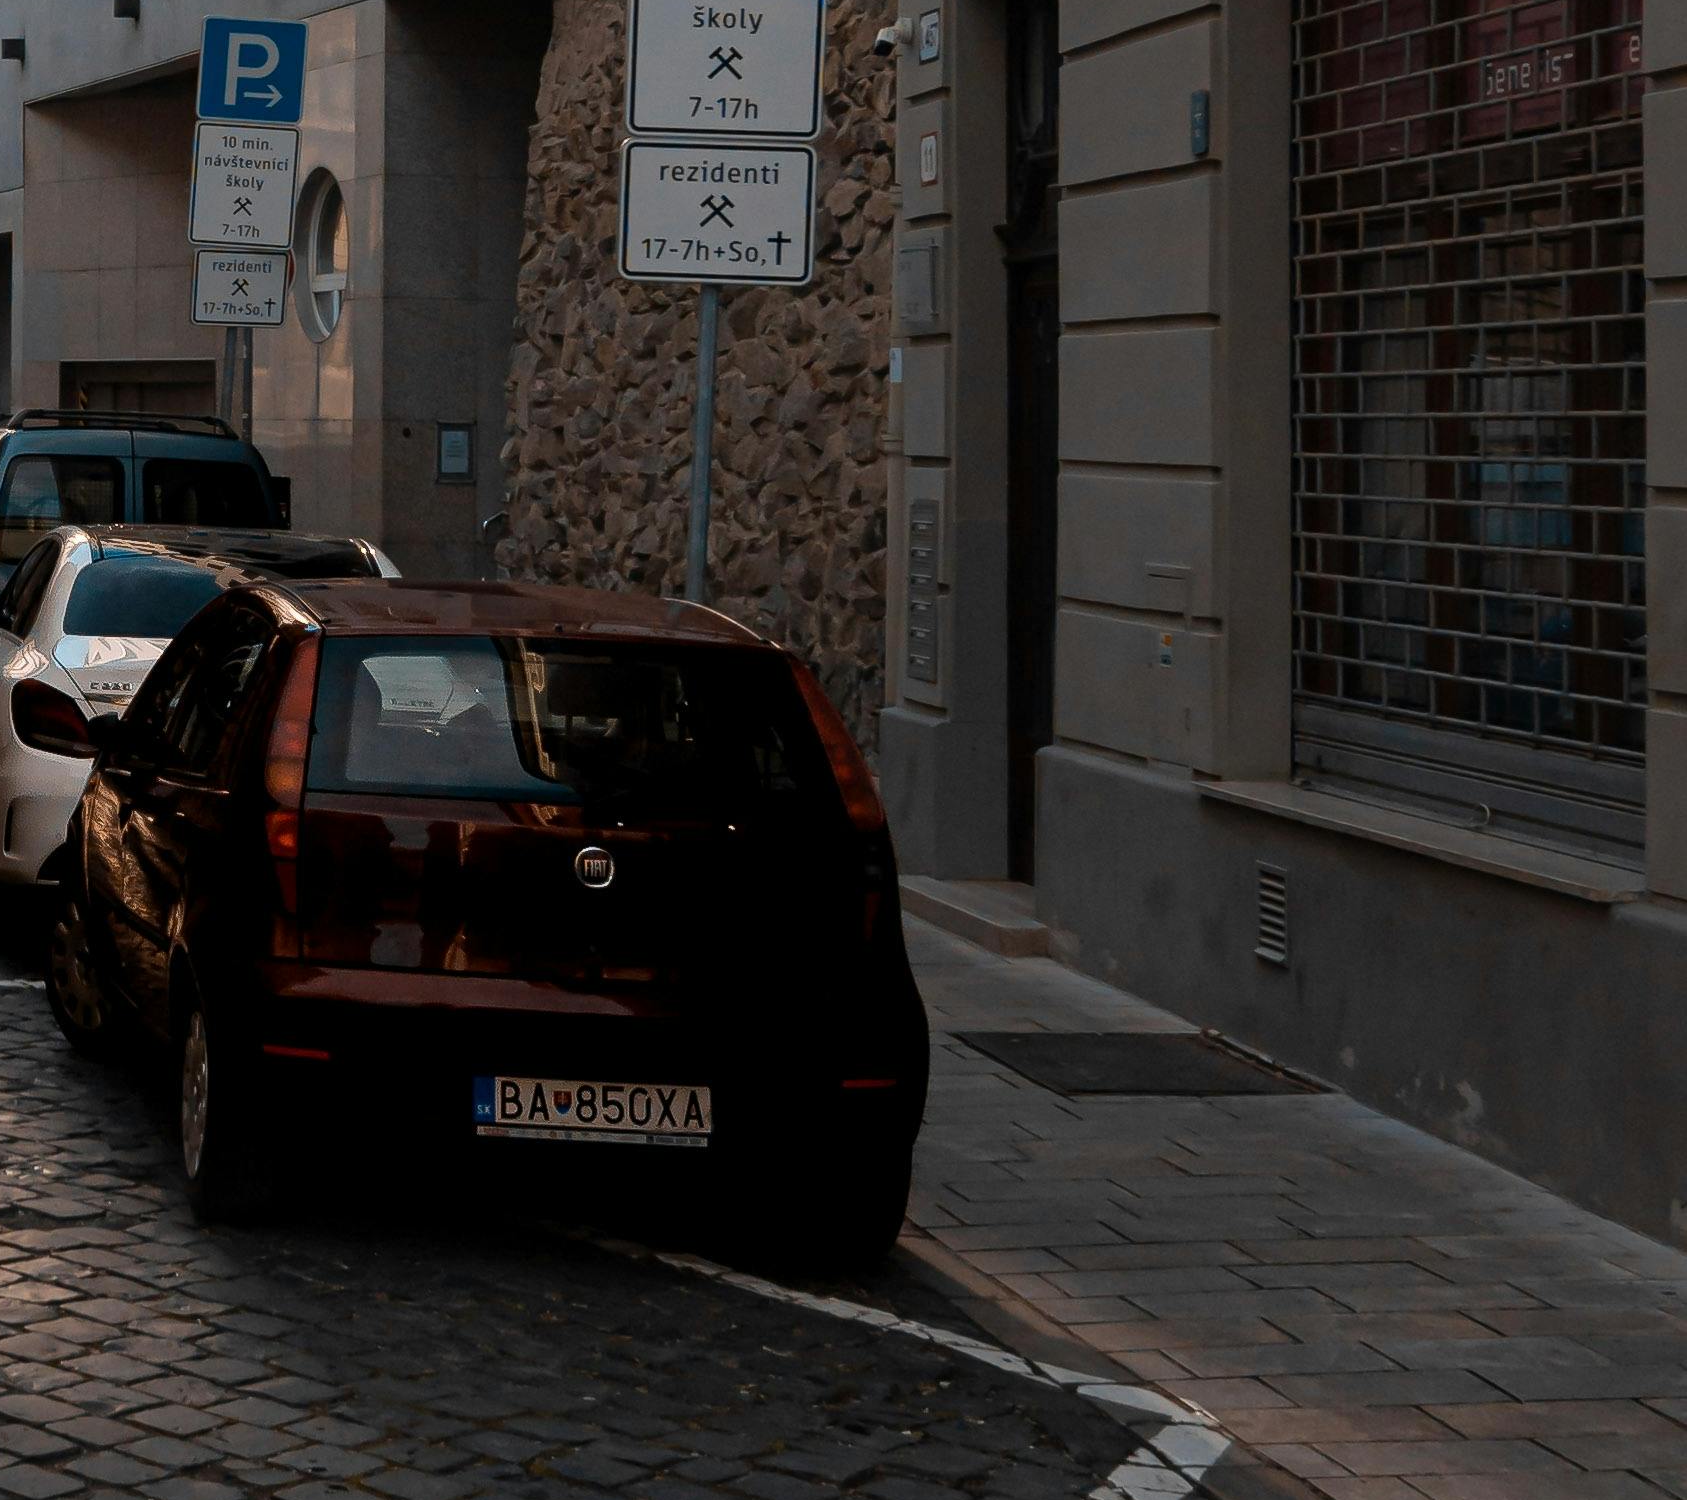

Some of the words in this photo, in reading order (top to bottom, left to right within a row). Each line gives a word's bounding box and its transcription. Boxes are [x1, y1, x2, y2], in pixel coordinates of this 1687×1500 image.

[692, 5, 763, 34] školy
[224, 32, 280, 106] P
[688, 96, 758, 119] 7-17h
[222, 135, 237, 148] 10
[242, 137, 273, 151] min.
[204, 154, 289, 171] návštevníci
[659, 160, 780, 184] rezidenti
[225, 174, 264, 191] školy
[222, 223, 260, 238] 7-17h
[212, 259, 272, 273] rezidenti
[583, 859, 608, 878] FIAT
